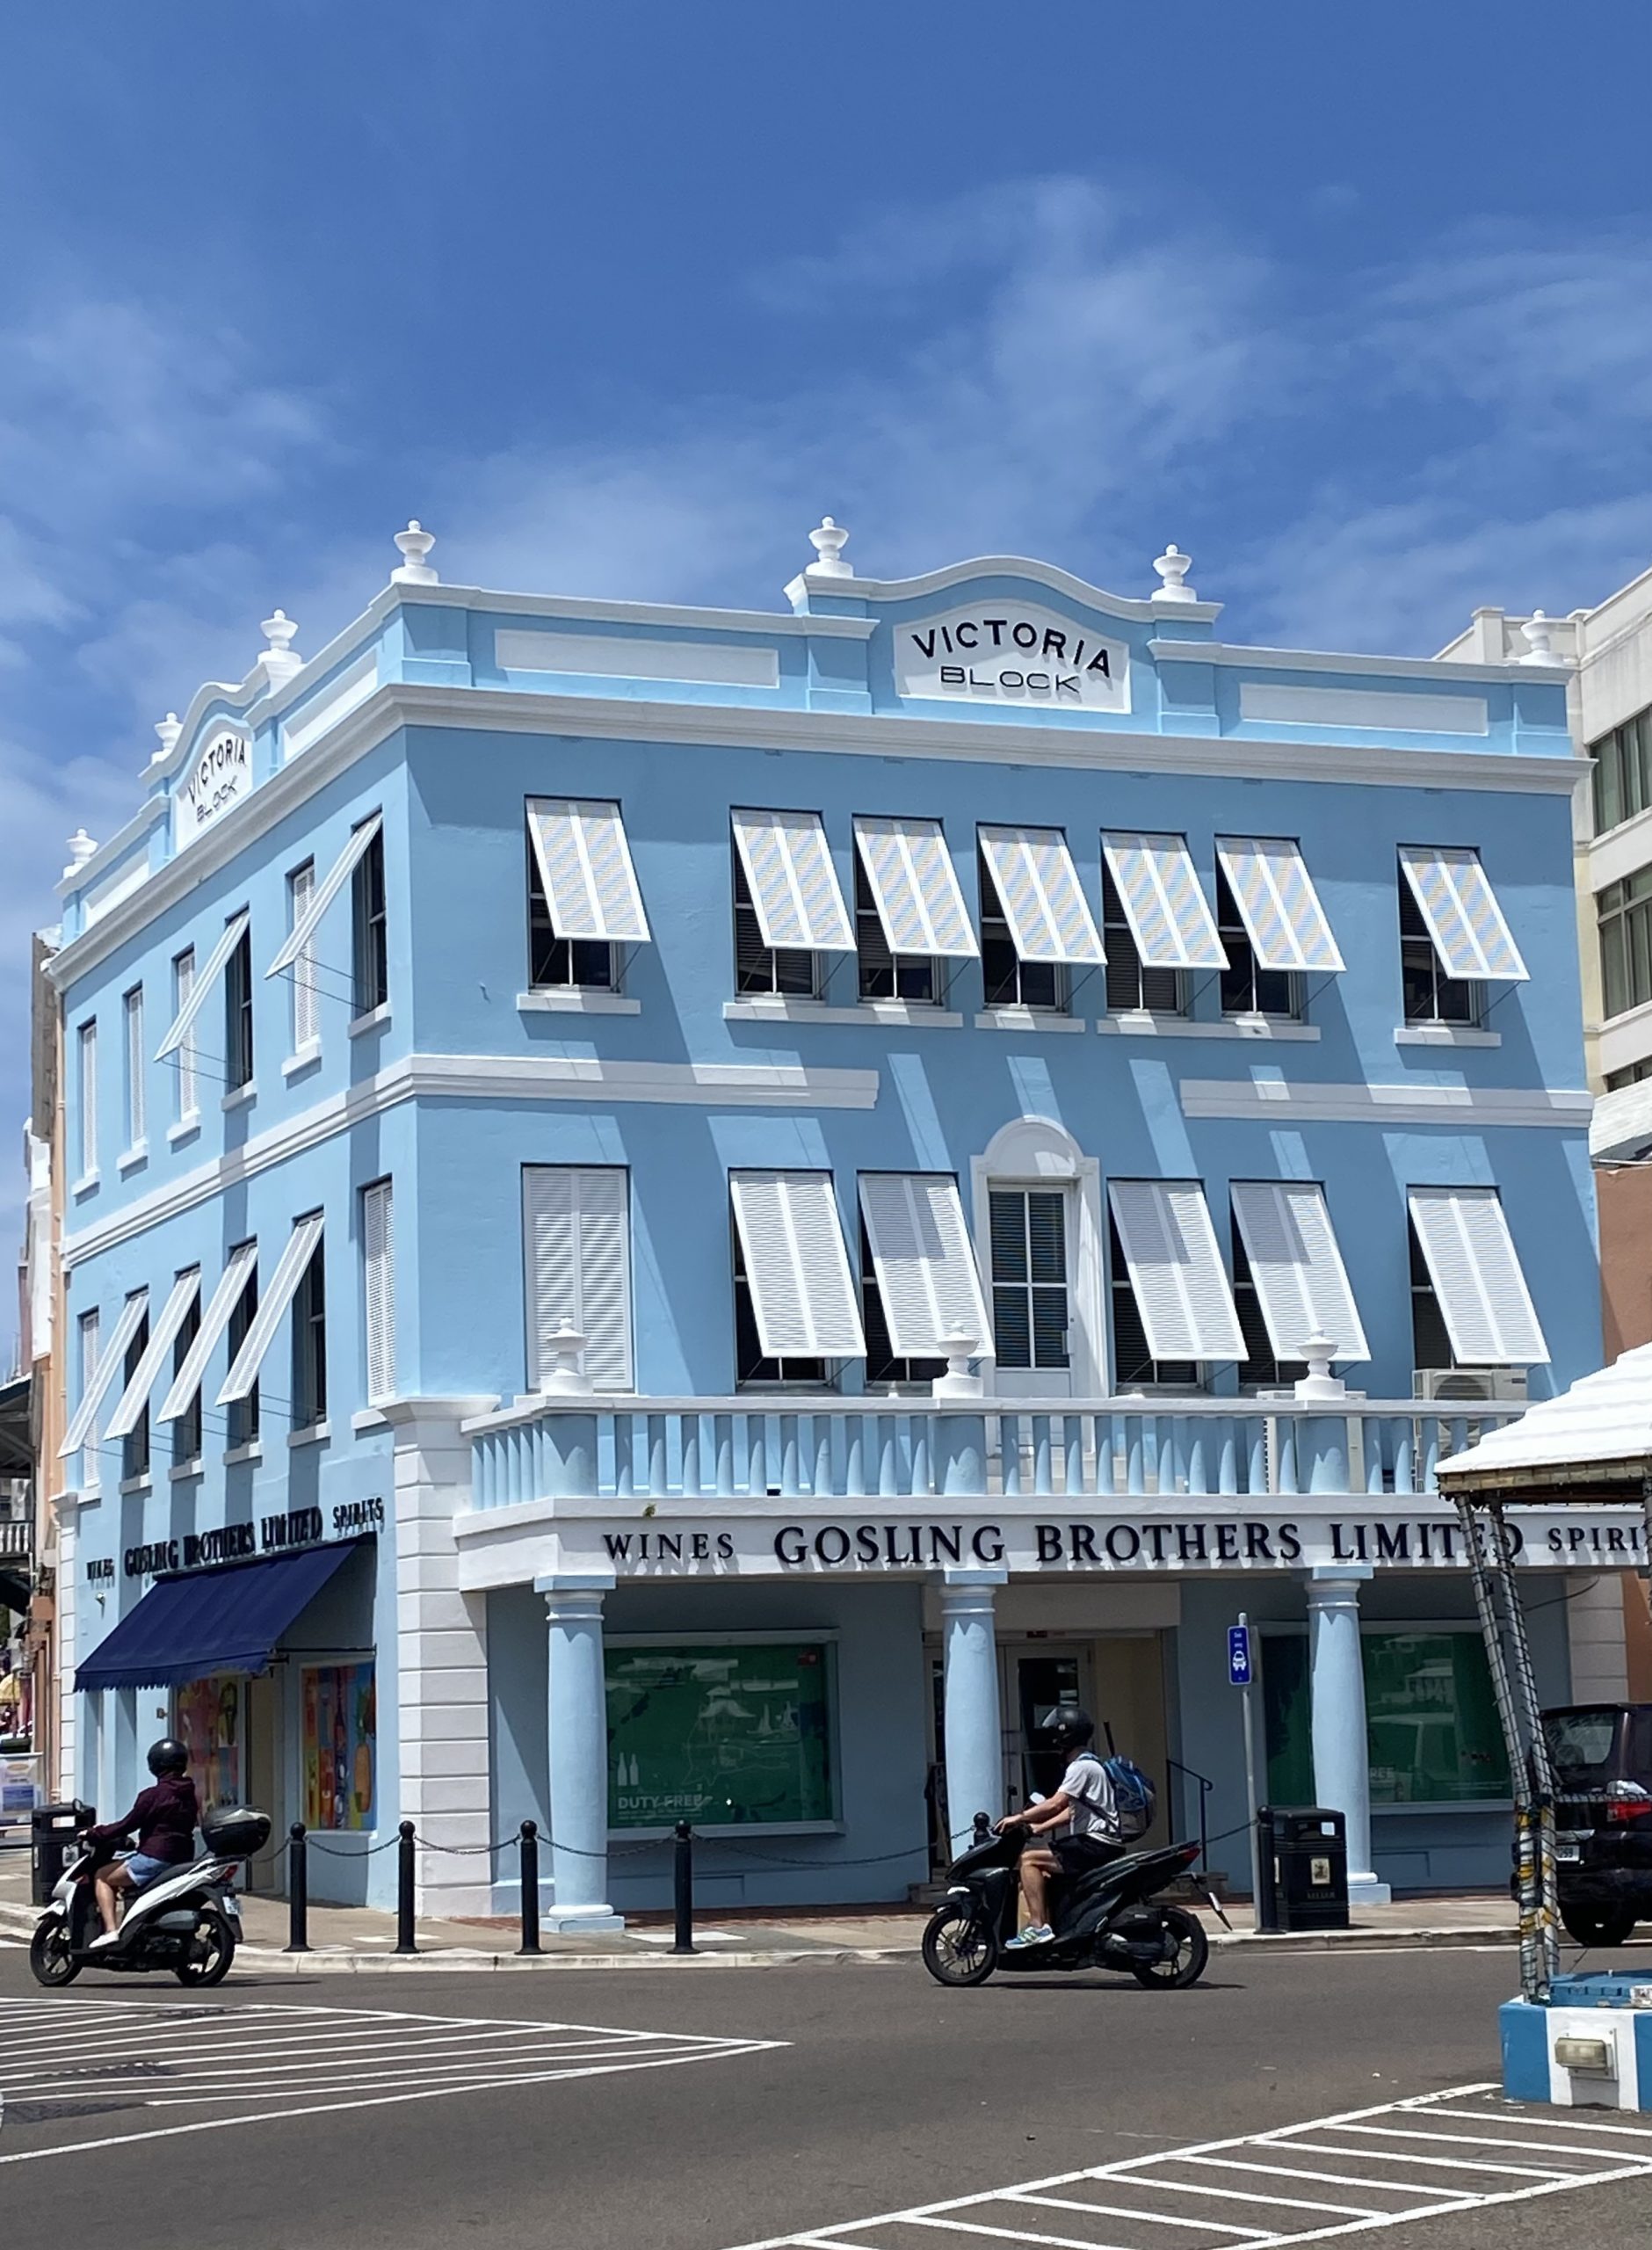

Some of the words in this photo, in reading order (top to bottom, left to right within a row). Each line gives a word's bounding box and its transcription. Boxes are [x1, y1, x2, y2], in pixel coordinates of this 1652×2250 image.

[911, 619, 1111, 679] VICTORIA
[940, 665, 1080, 694] BLOCK
[188, 737, 246, 804] VICTORIA
[197, 775, 237, 823] BLOCK
[332, 1497, 384, 1529] SPIRITS
[603, 1533, 735, 1561] WINES
[774, 1525, 1006, 1564] GOSLING
[1034, 1522, 1302, 1562] BROTHERS
[1547, 1526, 1646, 1552] SPIRI
[618, 1796, 659, 1809] DUTY
[664, 1794, 703, 1807] FREE
